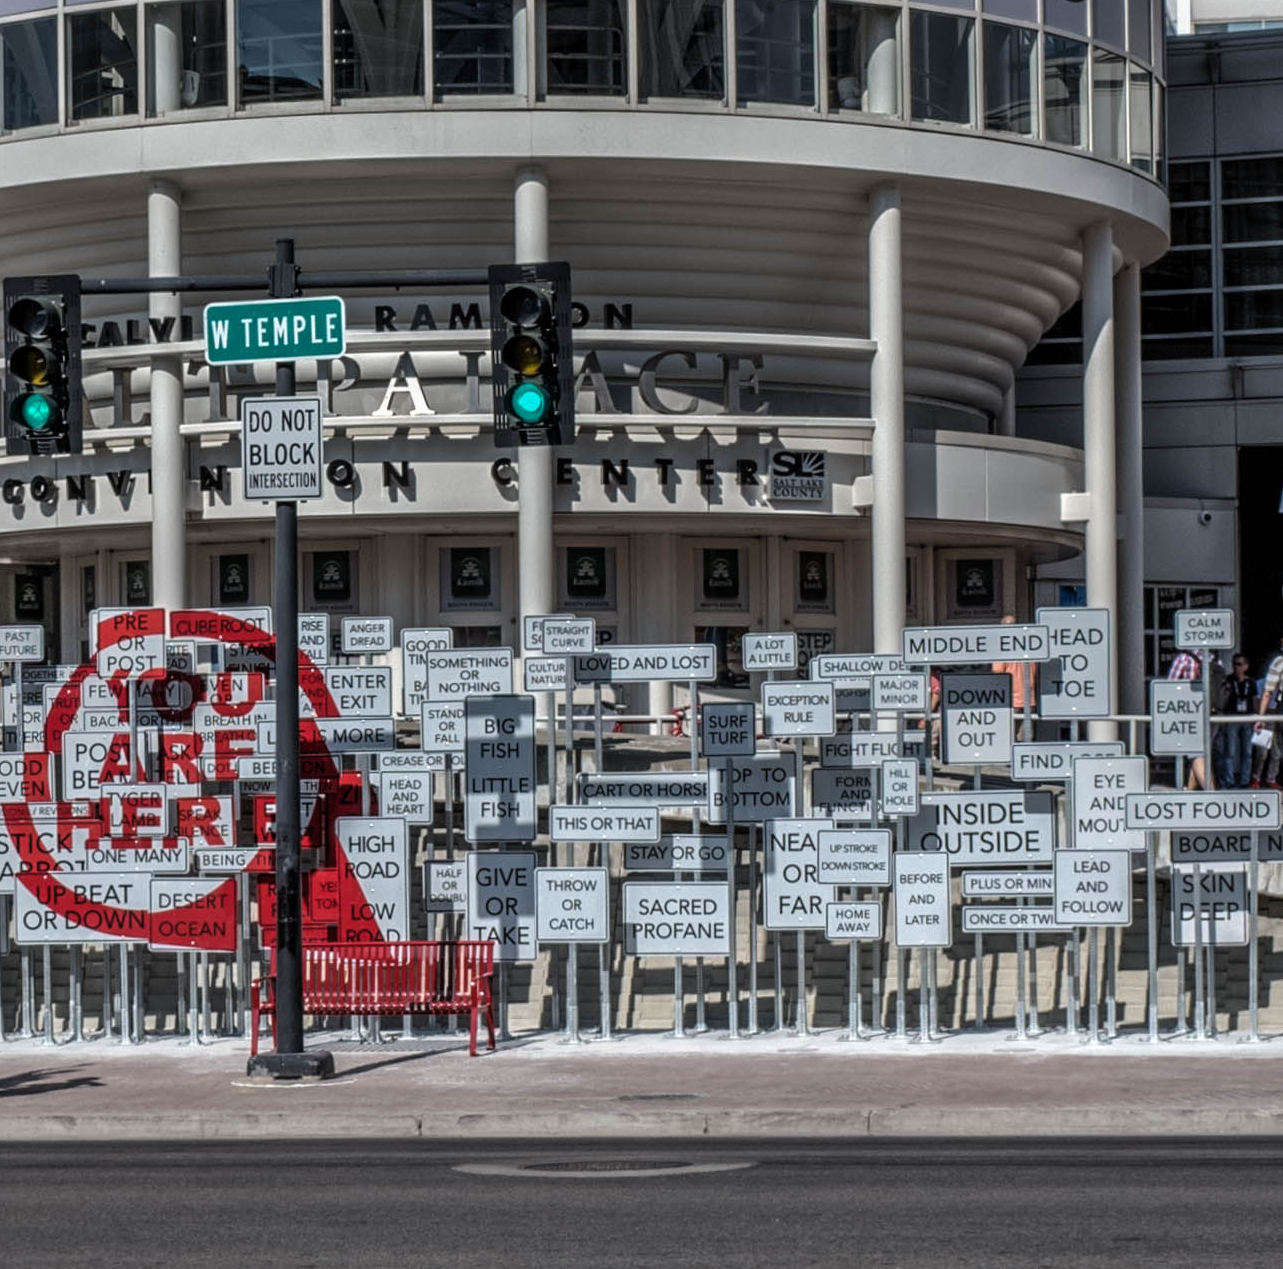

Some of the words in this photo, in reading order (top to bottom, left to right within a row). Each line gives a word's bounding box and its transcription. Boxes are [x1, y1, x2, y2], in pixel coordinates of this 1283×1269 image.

[374, 302, 633, 331] RAMON
[211, 320, 230, 349] W
[244, 312, 339, 348] TEMPLE
[250, 411, 273, 432] DO
[280, 409, 316, 431] NOT
[250, 443, 316, 465] BLOCK
[491, 457, 758, 489] CENTER
[249, 472, 317, 489] INTERSECTION
[774, 479, 795, 487] SALT
[774, 489, 823, 498] COUNTY
[350, 625, 385, 633] ANGER
[1188, 619, 1221, 628] CALM
[350, 637, 385, 646] DREAD
[1184, 631, 1224, 641] STORM
[909, 637, 986, 653] MIDDLE
[1001, 635, 1043, 651] END
[430, 657, 508, 669] SOMETHING
[331, 675, 386, 689] ENTER
[439, 682, 500, 693] NOTHING
[340, 695, 376, 709] EXIT
[768, 695, 829, 705] EXCEPTION
[947, 689, 1006, 705] DOWN
[1158, 700, 1203, 713] EARLY
[709, 715, 748, 728] SURF
[784, 712, 814, 723] RULE
[484, 718, 515, 734] BIG
[1161, 721, 1197, 734] LATE
[709, 731, 748, 744] TURF
[480, 743, 519, 759] FISH
[472, 778, 529, 793] LITTLE
[481, 801, 520, 818] FISH
[936, 803, 1024, 825] INSIDE
[1135, 802, 1186, 820] LOST
[1193, 801, 1270, 819] FOUND
[348, 835, 395, 853] HIGH
[920, 831, 1040, 853] OUTSIDE
[476, 868, 527, 886] GIVE
[900, 874, 943, 884] BEFORE
[546, 880, 597, 892] THROW
[159, 893, 228, 908] DESERT
[638, 899, 717, 915] SACRED
[1062, 900, 1124, 914] FOLLOW
[549, 918, 594, 930] CATCH
[905, 915, 939, 925] LATER
[159, 921, 226, 936] OCEAN
[632, 923, 724, 939] PROFANE
